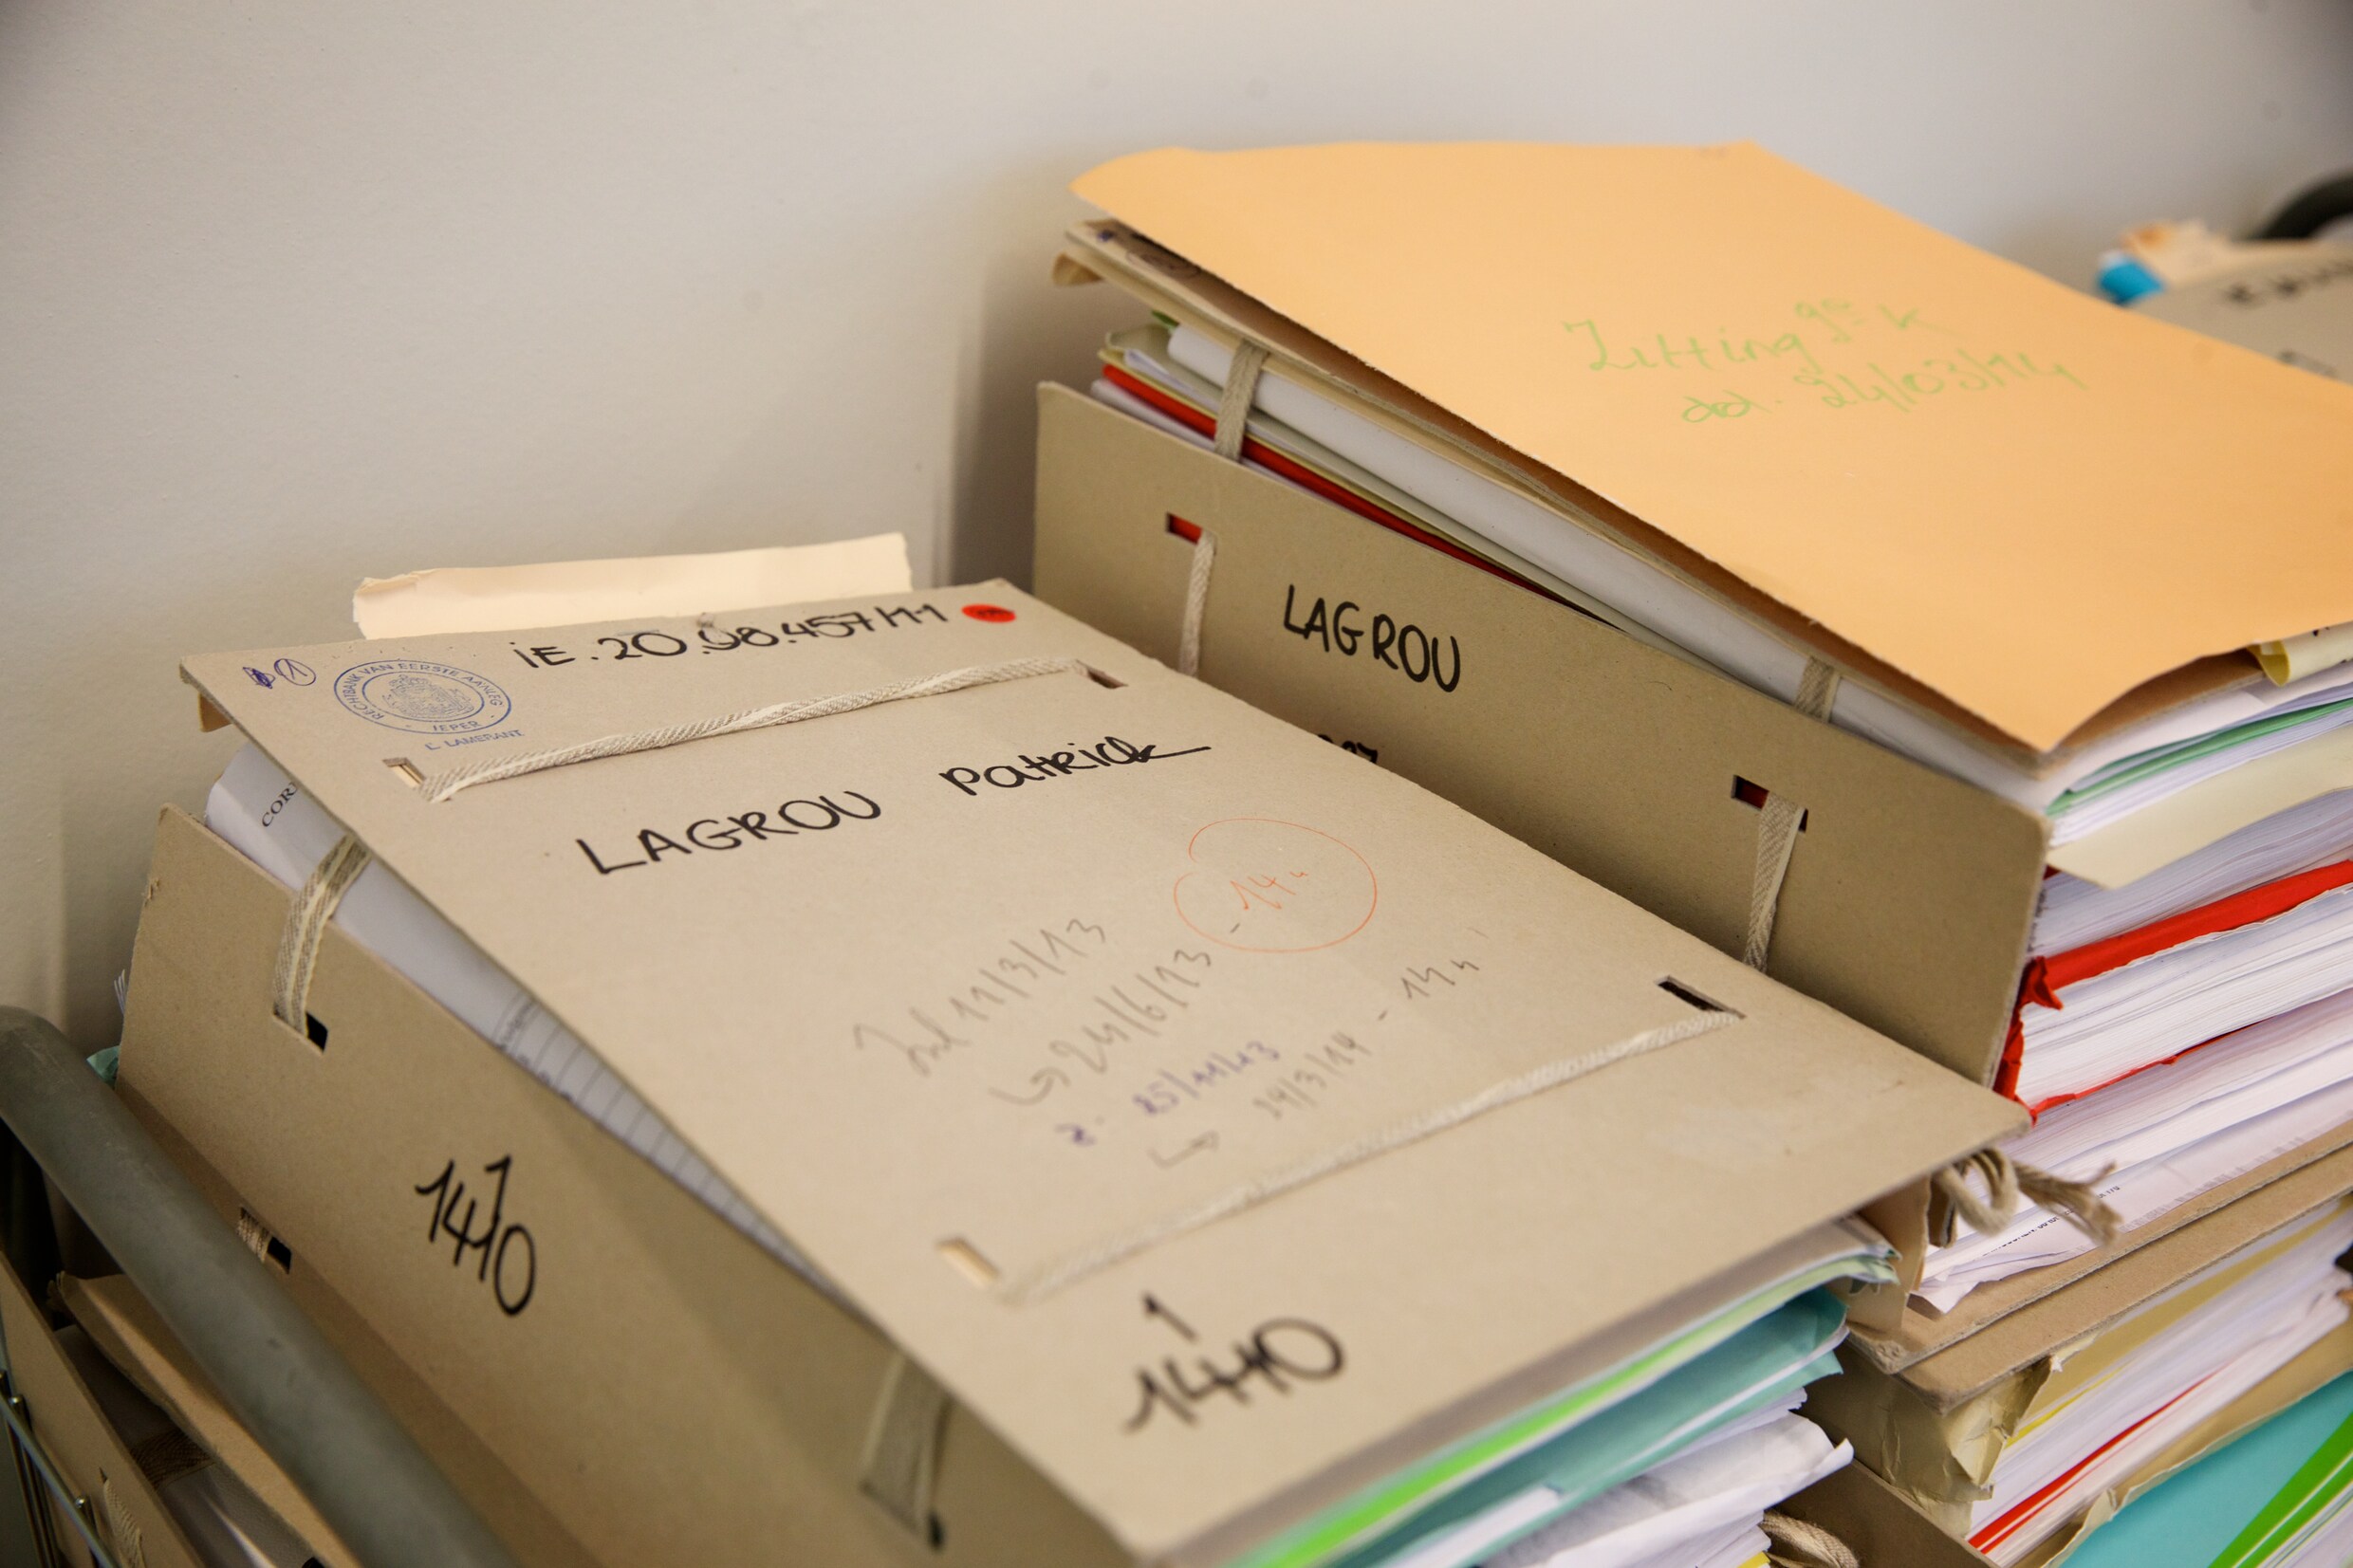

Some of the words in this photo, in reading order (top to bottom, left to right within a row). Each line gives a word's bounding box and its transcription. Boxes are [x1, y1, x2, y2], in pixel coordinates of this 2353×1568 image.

[1284, 583, 1462, 693] LAGROU
[360, 663, 395, 675] VAN
[398, 663, 460, 677] EERSTE
[342, 673, 385, 720] RECHTBANK
[461, 675, 505, 707] AANLEG
[433, 720, 482, 732] IEPER
[262, 782, 298, 827] COR
[575, 789, 883, 876] LAGROU
